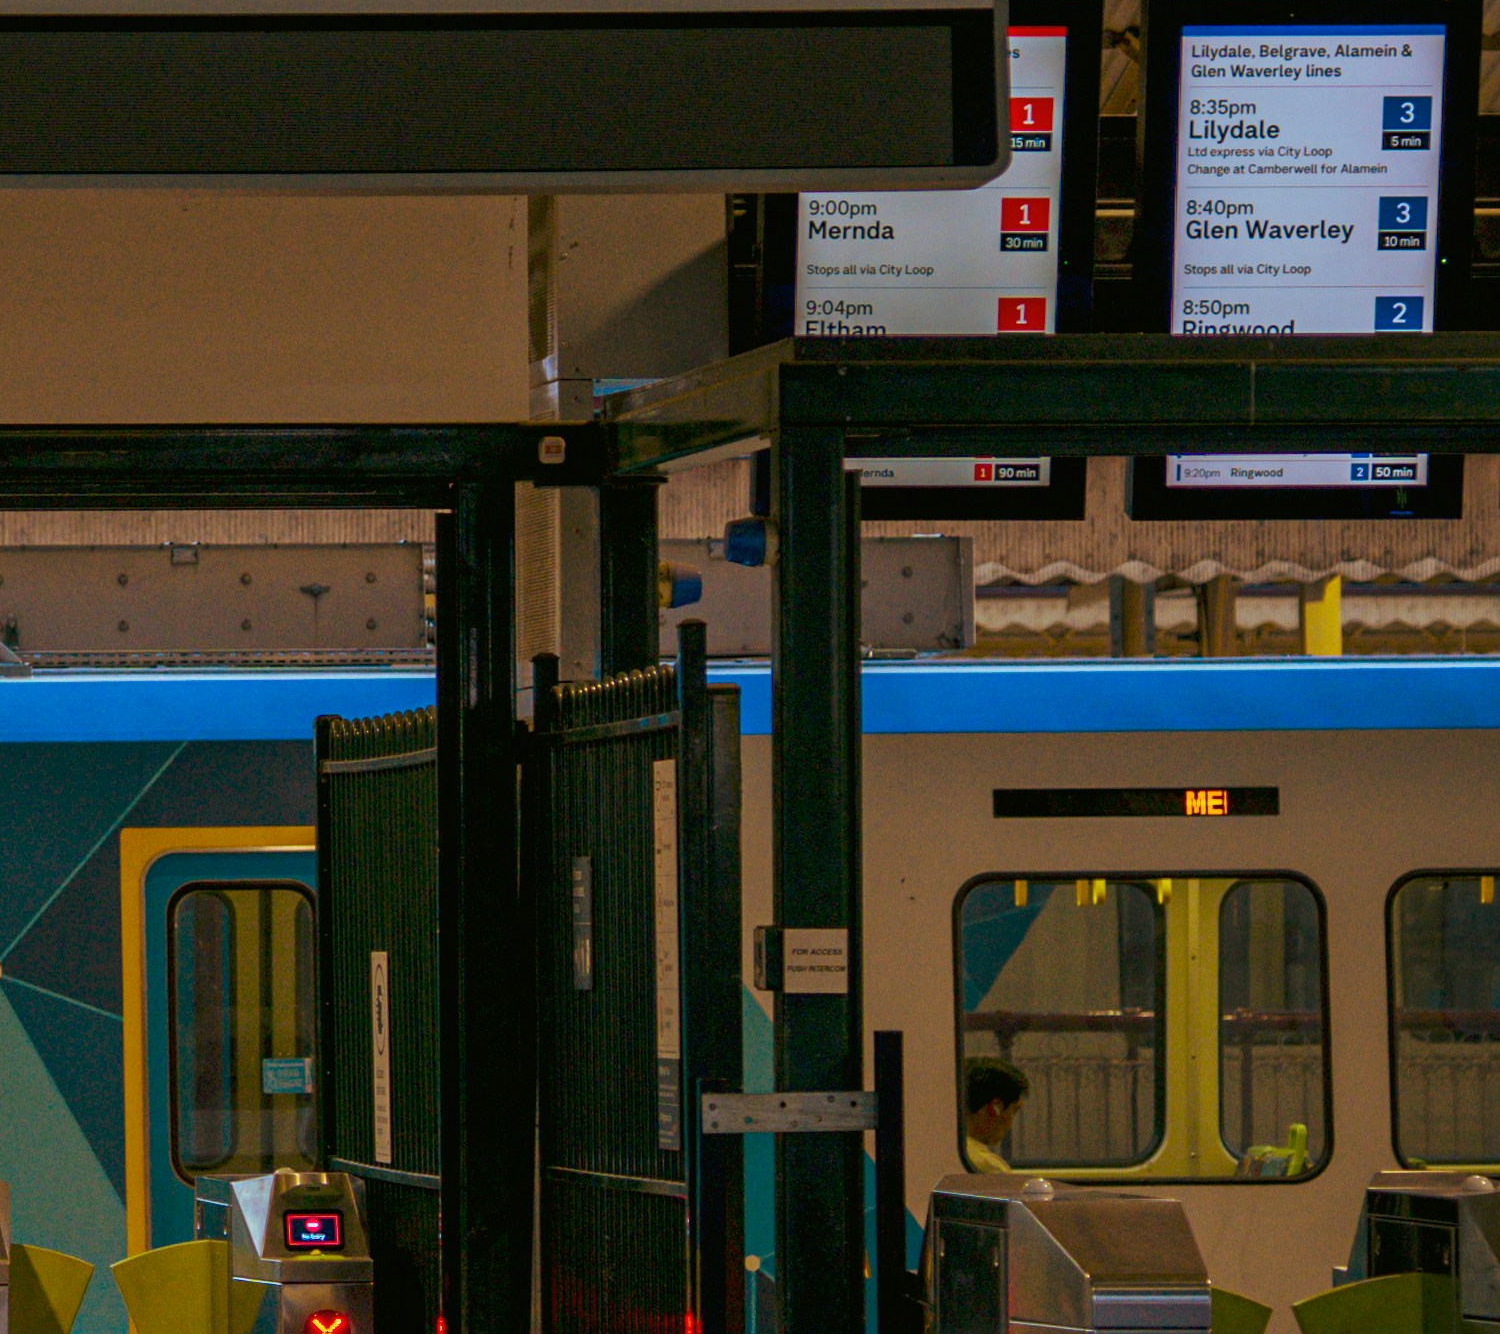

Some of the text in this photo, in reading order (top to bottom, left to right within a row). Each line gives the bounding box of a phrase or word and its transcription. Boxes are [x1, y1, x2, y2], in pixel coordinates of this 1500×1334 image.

[1192, 44, 1412, 60] Lilydale, Belgrave, Alamein &
[1191, 65, 1342, 80] Glen Waverley lines
[1023, 104, 1034, 124] 1
[1190, 100, 1256, 117] 8:35pm
[1400, 103, 1414, 123] 3
[1189, 120, 1280, 143] Lilydale
[1026, 137, 1045, 148] min
[1391, 136, 1421, 146] 5 min
[1188, 146, 1332, 159] Ltd express via City Loop
[1188, 163, 1387, 176] Change at Camberwell for Alamein
[809, 200, 876, 217] 9:00pm
[1020, 204, 1030, 224] 1
[1187, 201, 1253, 218] 8:40pm
[1396, 203, 1410, 223] 3
[808, 221, 894, 239] Mernda
[1186, 220, 1354, 243] Glen Waverley
[1005, 237, 1042, 248] 30 min
[1385, 236, 1419, 246] 10 min
[807, 264, 934, 278] Stops all via City Loop
[1184, 264, 1311, 277] Stops all via City Loop
[806, 301, 872, 318] 9:04pm
[1016, 304, 1026, 324] 1
[1183, 301, 1249, 318] 8:50pm
[1392, 303, 1406, 323] 2
[999, 468, 1036, 478] 90 min
[1230, 468, 1283, 479] Ringwood
[1376, 467, 1414, 478] 50 min
[1186, 790, 1228, 816] ME
[792, 948, 843, 956] FOR ACCESS
